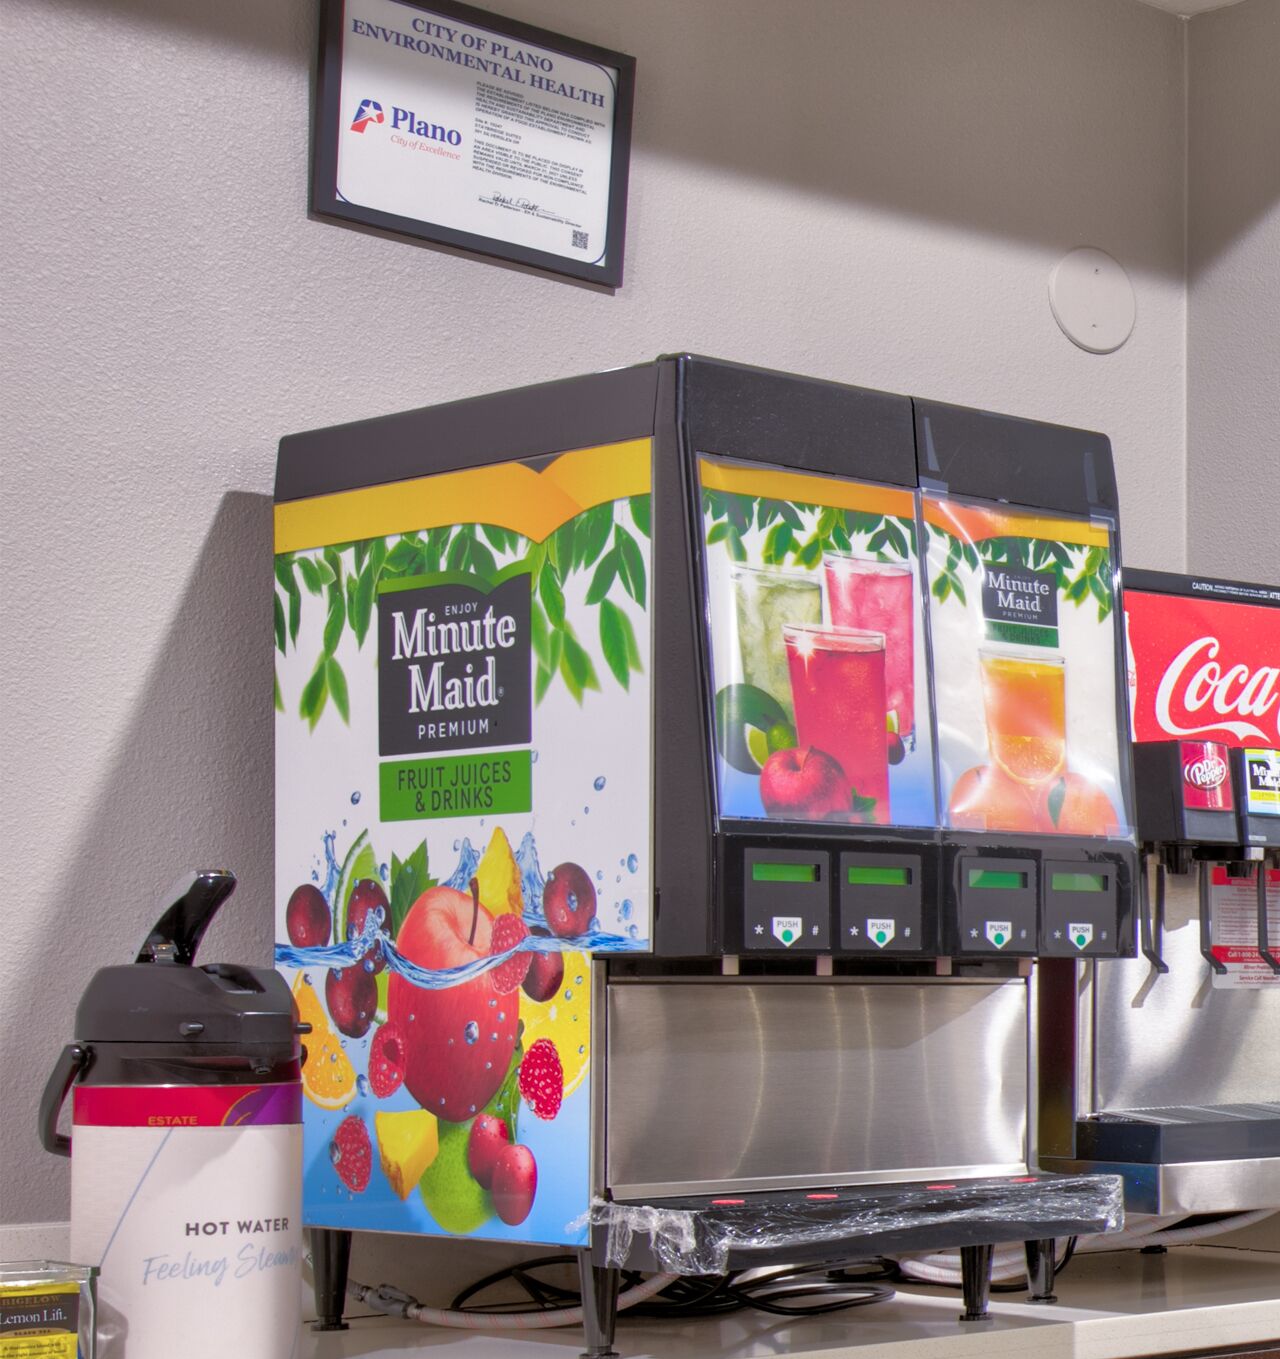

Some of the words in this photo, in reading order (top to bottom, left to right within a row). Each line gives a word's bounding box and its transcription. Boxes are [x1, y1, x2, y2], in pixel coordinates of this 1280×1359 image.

[411, 17, 459, 43] CITY
[461, 32, 487, 50] OF
[491, 41, 554, 73] PLANO
[351, 18, 526, 84] ENVIRONMENTAL
[530, 73, 606, 109] HEALTH
[390, 105, 463, 147] Plano
[390, 133, 407, 148] City
[408, 139, 418, 151] of
[418, 141, 462, 161] Excellence
[988, 571, 1050, 595] Minute
[1192, 582, 1213, 592] CAUTION
[444, 602, 478, 616] ENJOY
[997, 590, 1042, 613] Maid
[1002, 610, 1038, 620] PREMIUM
[391, 605, 516, 660] Minute
[408, 656, 499, 713] Maid
[418, 718, 489, 740] PREMIUM
[397, 766, 445, 791] FRUIT
[450, 760, 511, 788] JUICES
[1191, 762, 1224, 785] Pepper
[1203, 759, 1216, 771] Dr
[415, 792, 426, 813] &
[431, 785, 493, 811] DRINKS
[776, 919, 799, 929] PUSH
[870, 921, 892, 931] PUSH
[989, 923, 1009, 932] PUSH
[1071, 925, 1090, 934] PUSH
[148, 1115, 198, 1126] ESTATE
[185, 1221, 230, 1237] HOT
[237, 1217, 289, 1234] WATER
[142, 1250, 229, 1287] Feeling
[0, 1312, 41, 1324] Lemon
